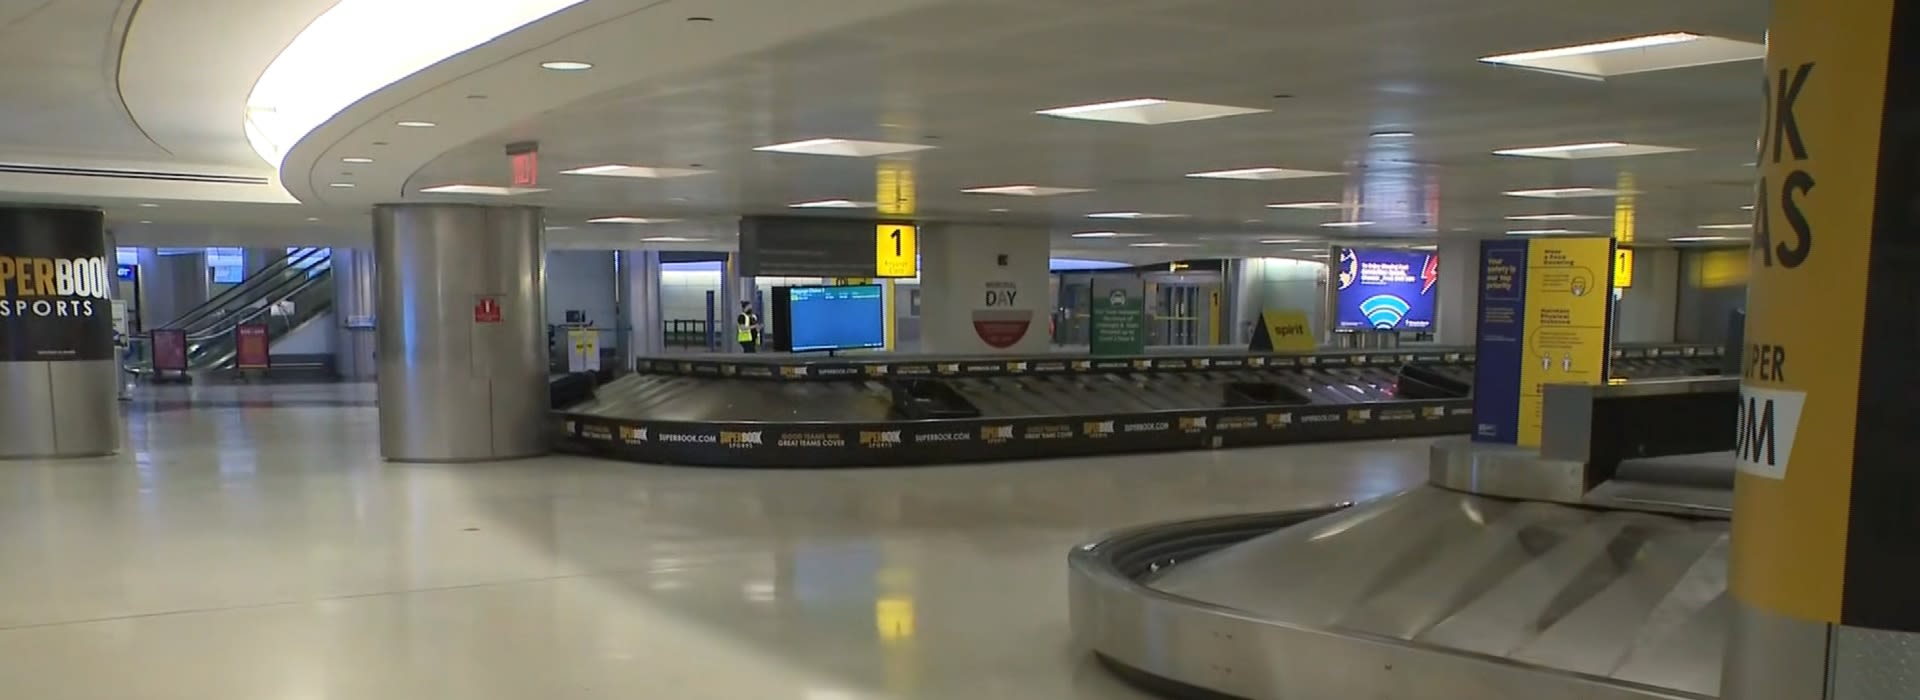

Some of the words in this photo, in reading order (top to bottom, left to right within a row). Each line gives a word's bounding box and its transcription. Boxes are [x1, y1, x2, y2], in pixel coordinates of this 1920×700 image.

[890, 228, 901, 257] 1
[1619, 252, 1625, 273] 1
[986, 290, 1017, 307] DAY
[0, 300, 92, 316] SPORTS
[1275, 324, 1304, 337] spirit
[1745, 344, 1785, 382] PER
[659, 432, 717, 444] SUPERBOOK.COM
[719, 430, 763, 445] SUPERBOOK
[777, 439, 798, 447] GREAT
[800, 439, 822, 447] TEAMS
[823, 439, 845, 447] COVER
[915, 432, 971, 442] SUPERBOOK.COM
